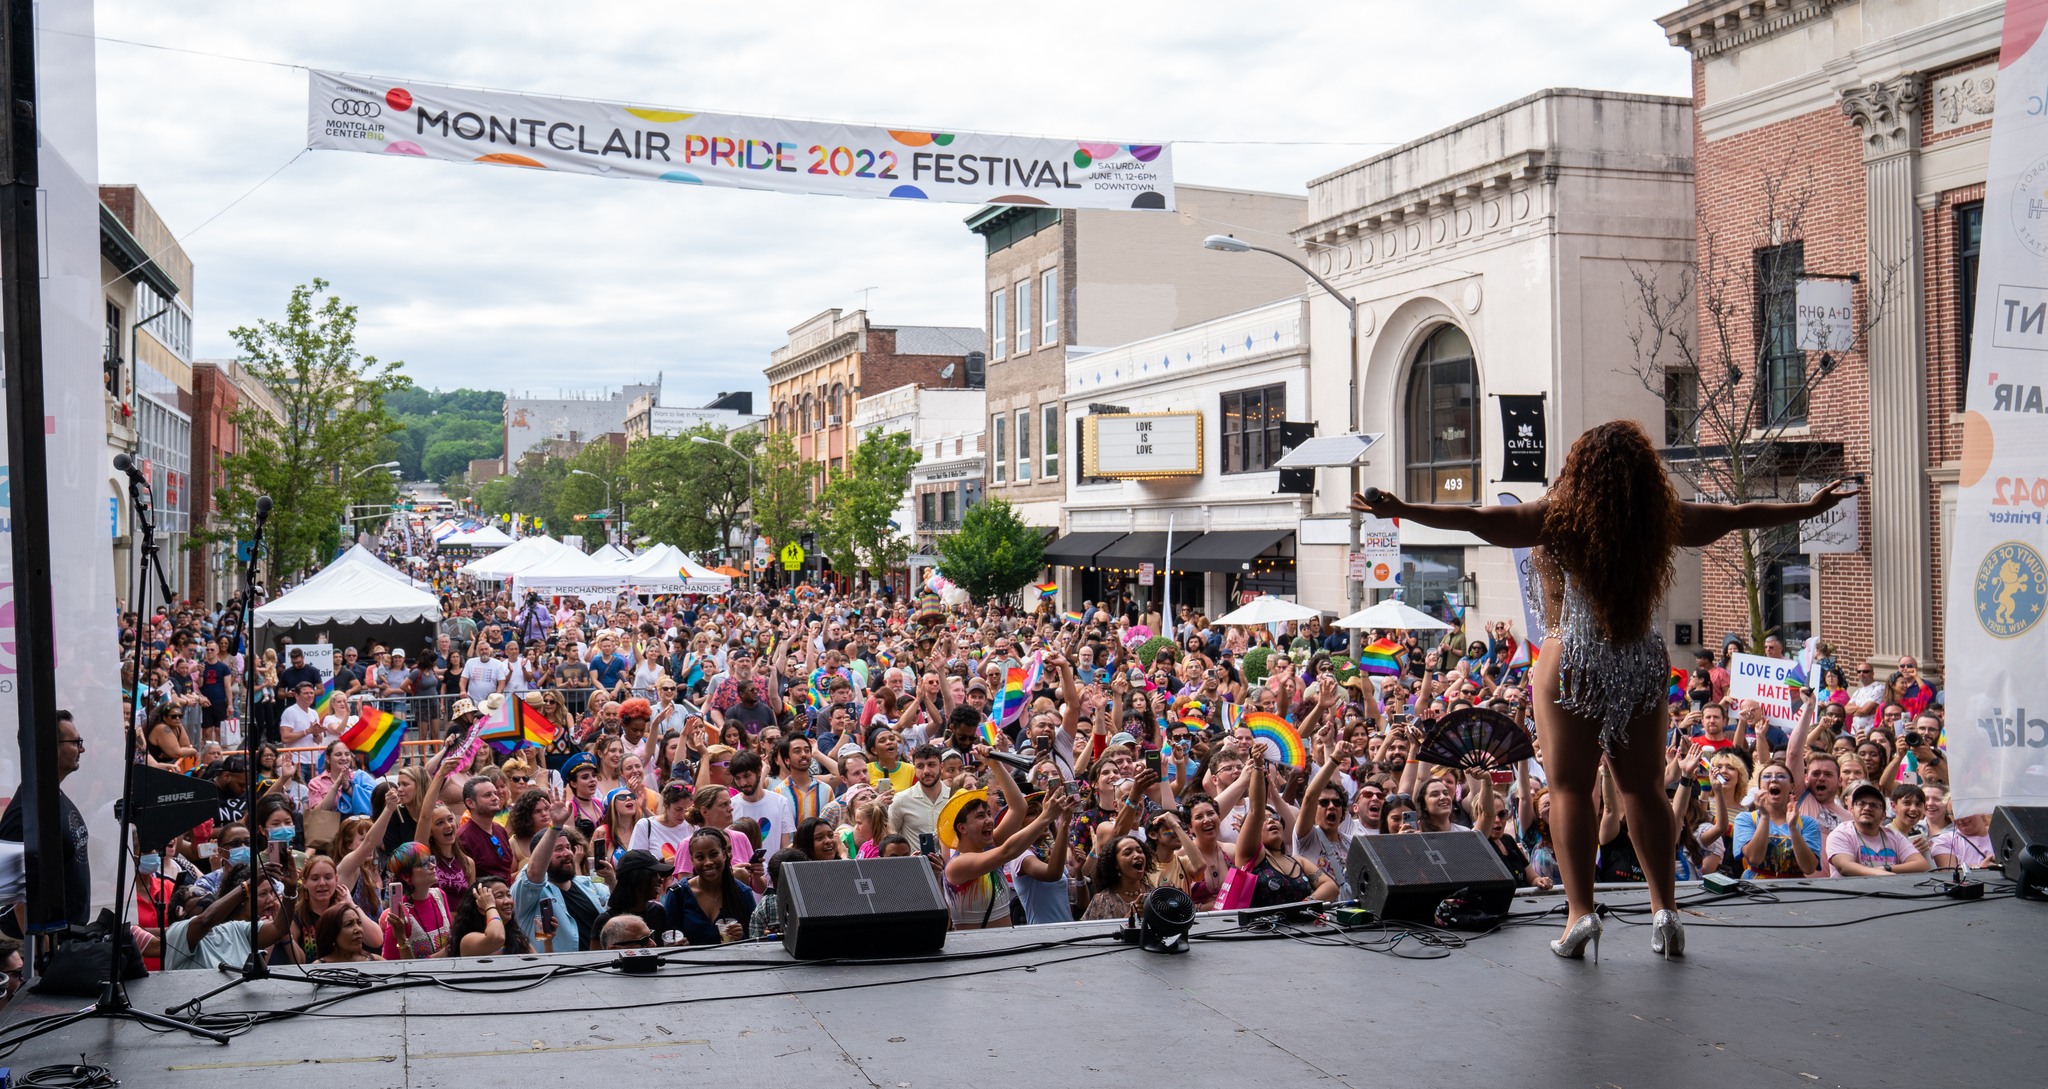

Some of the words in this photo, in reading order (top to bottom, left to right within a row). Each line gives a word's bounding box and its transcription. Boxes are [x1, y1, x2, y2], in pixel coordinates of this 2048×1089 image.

[326, 119, 385, 133] MONTCLAIR
[416, 106, 671, 162] MONTCLAIR
[685, 134, 798, 173] PRIDE
[807, 145, 899, 180] 2022
[912, 151, 1082, 189] FESTIVAL
[1098, 162, 1146, 170] SATURDAY
[1089, 172, 1112, 180] JUNE
[1114, 173, 1124, 181] 11,
[1125, 173, 1157, 181] 12-6PM
[1094, 182, 1154, 191] DOWNTOWN
[1799, 305, 1825, 319] RHG
[1828, 306, 1851, 320] A+D
[1136, 421, 1152, 431] LOVE
[1141, 433, 1148, 443] IS
[1136, 444, 1153, 454] LOVE
[1507, 439, 1544, 449] QWELL
[1444, 477, 1463, 491] 493
[1366, 537, 1398, 548] PRIDE
[555, 586, 617, 594] MERCHANDISE
[661, 584, 722, 593] MERCHANDISE
[1740, 661, 1771, 679] LOVE
[1757, 683, 1789, 701] HATE
[157, 791, 195, 803] SHURE
